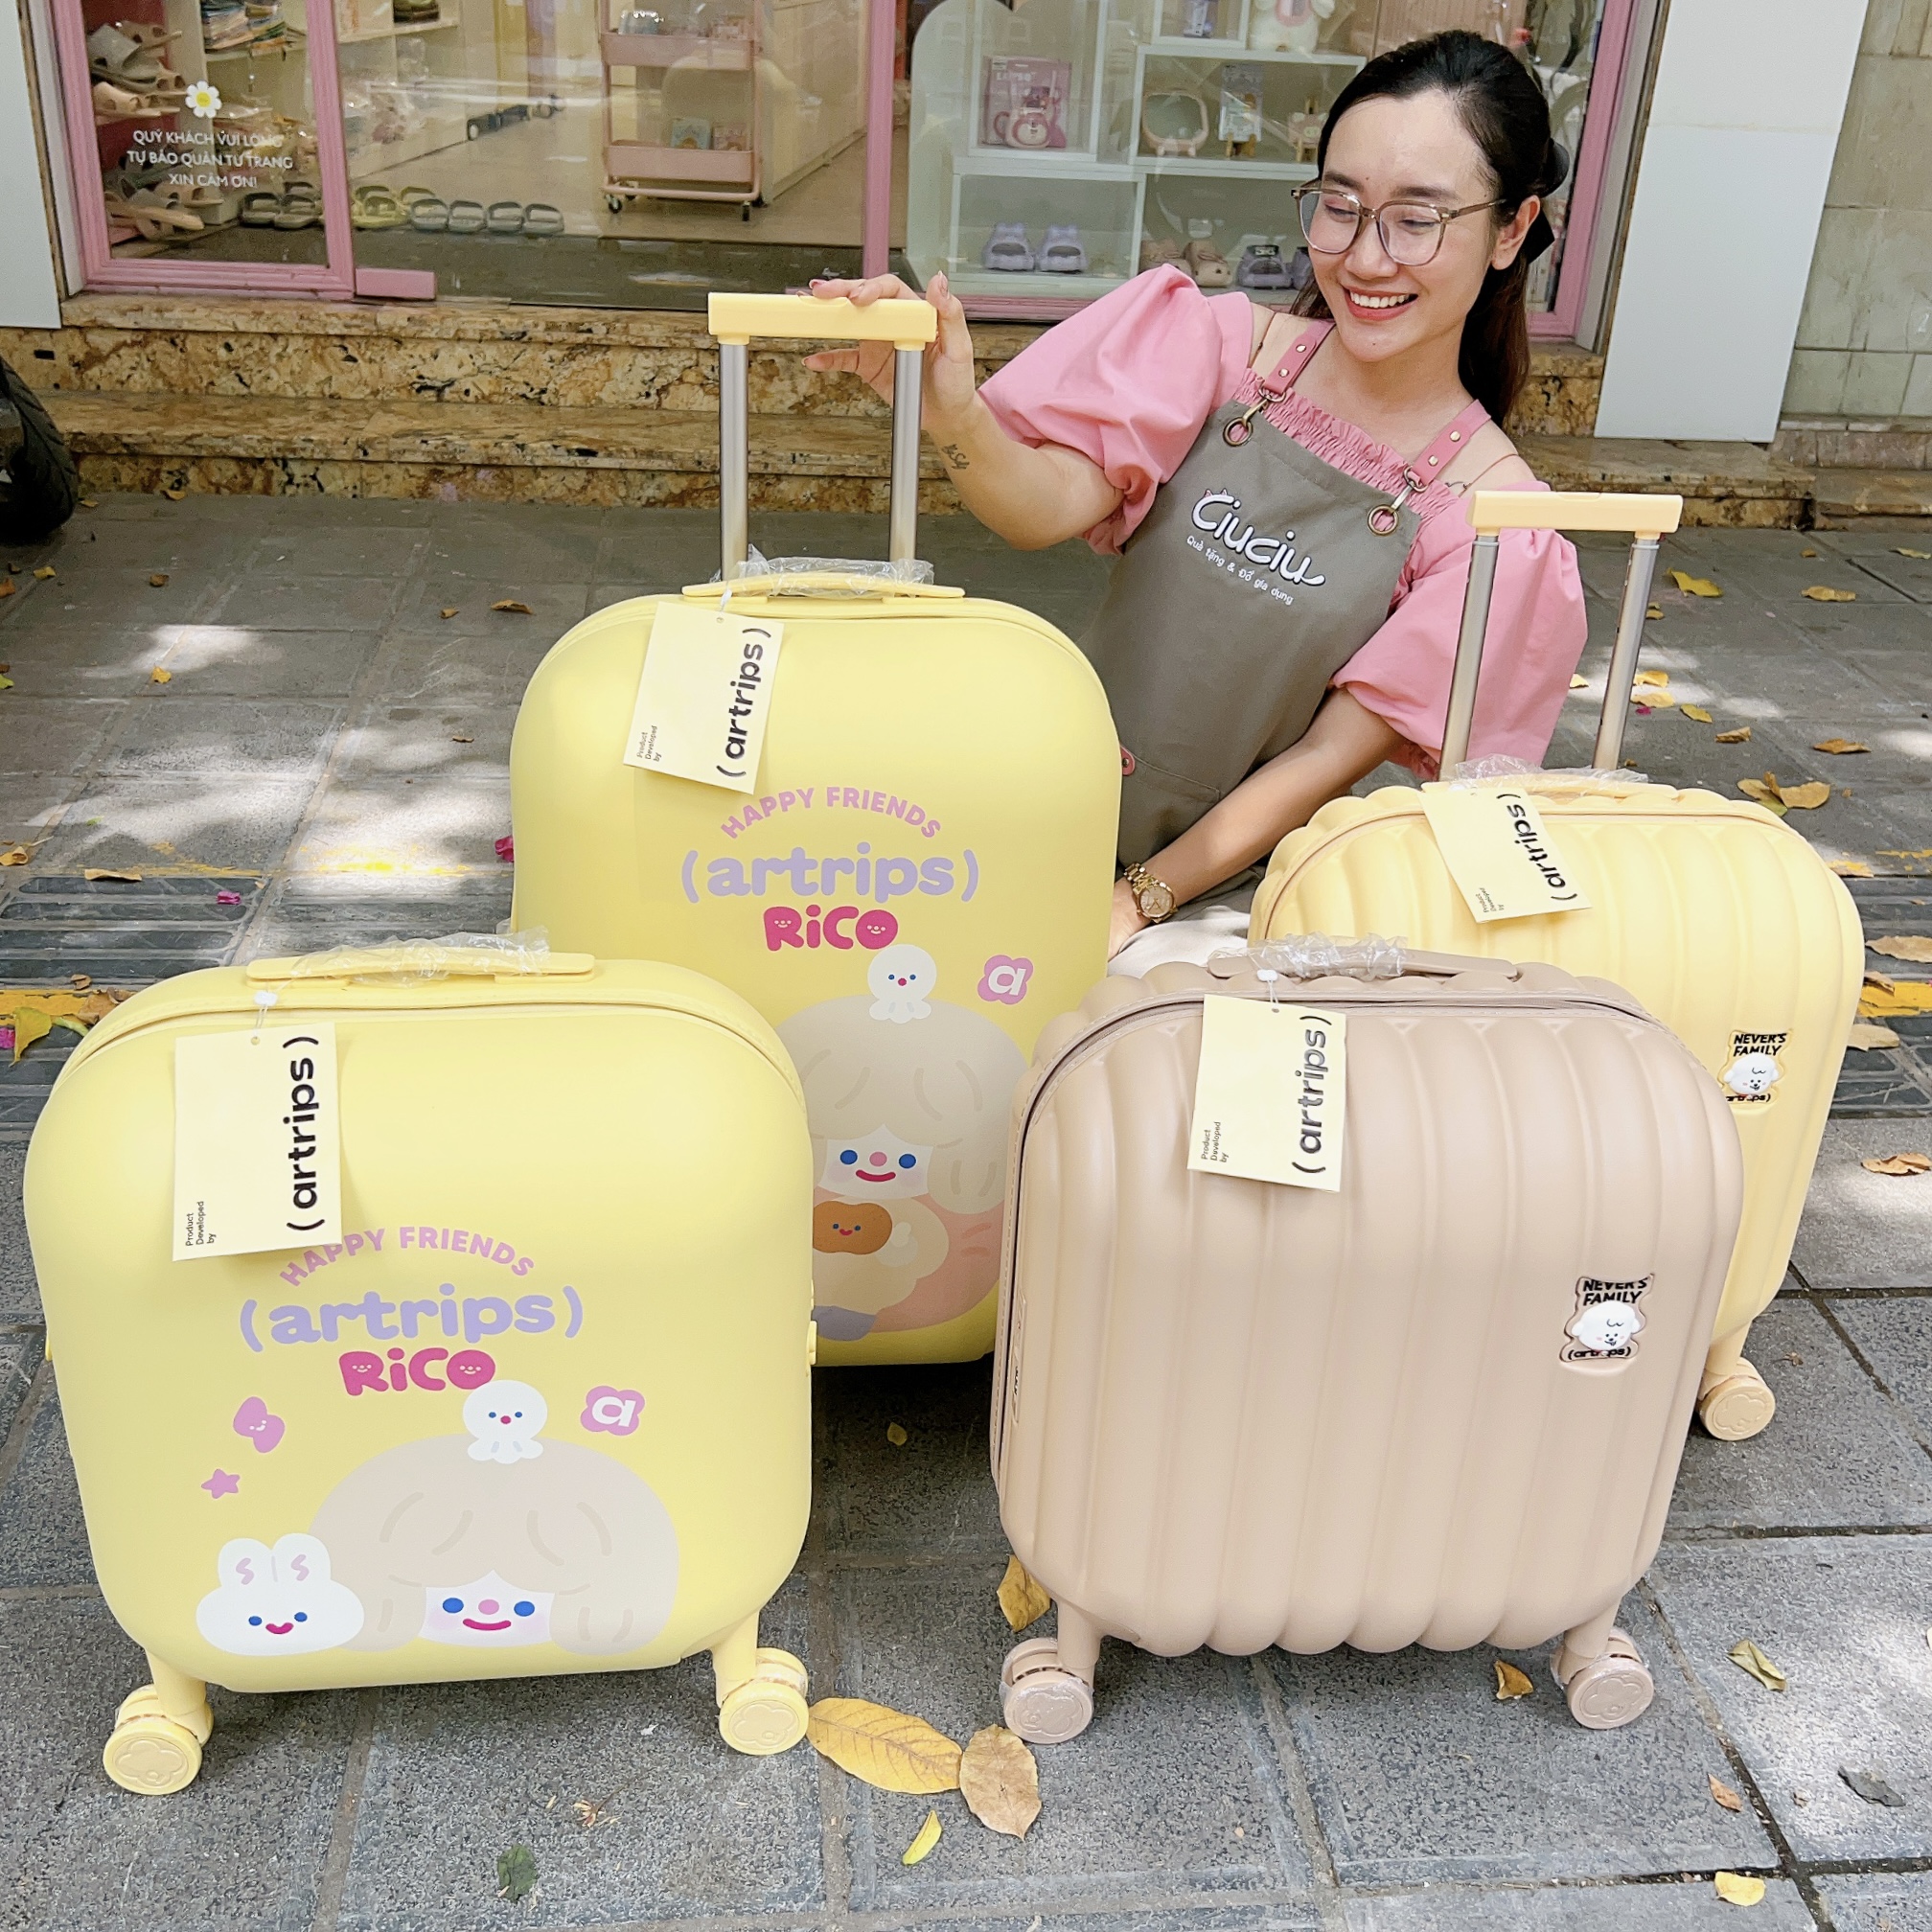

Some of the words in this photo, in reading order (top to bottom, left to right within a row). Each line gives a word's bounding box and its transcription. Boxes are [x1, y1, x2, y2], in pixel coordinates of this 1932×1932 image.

[165, 130, 214, 145] KHÁCH
[218, 132, 241, 147] VUI
[168, 173, 195, 186] XIN
[1186, 535, 1204, 552] Quà
[1227, 562, 1235, 573] &
[1270, 587, 1295, 606] dụng
[716, 628, 772, 778] (artrips)
[720, 787, 816, 840] HAPPY
[825, 786, 941, 839] FRIENDS
[681, 841, 979, 904] (artrips)
[1496, 794, 1578, 901] (artrips)
[1733, 1045, 1782, 1057] FAMILY
[1291, 1015, 1333, 1174] (artrips)
[282, 1036, 326, 1231] (artrips)
[1201, 1128, 1212, 1161] Product
[1219, 1152, 1230, 1163] by
[185, 1212, 195, 1247] Product
[196, 1200, 205, 1246] Developed
[206, 1231, 218, 1245] by
[279, 1228, 386, 1287] HAPPY
[399, 1226, 536, 1276] FRIENDS
[240, 1282, 584, 1353] (artrips)
[1582, 1290, 1643, 1306] FAMILY
